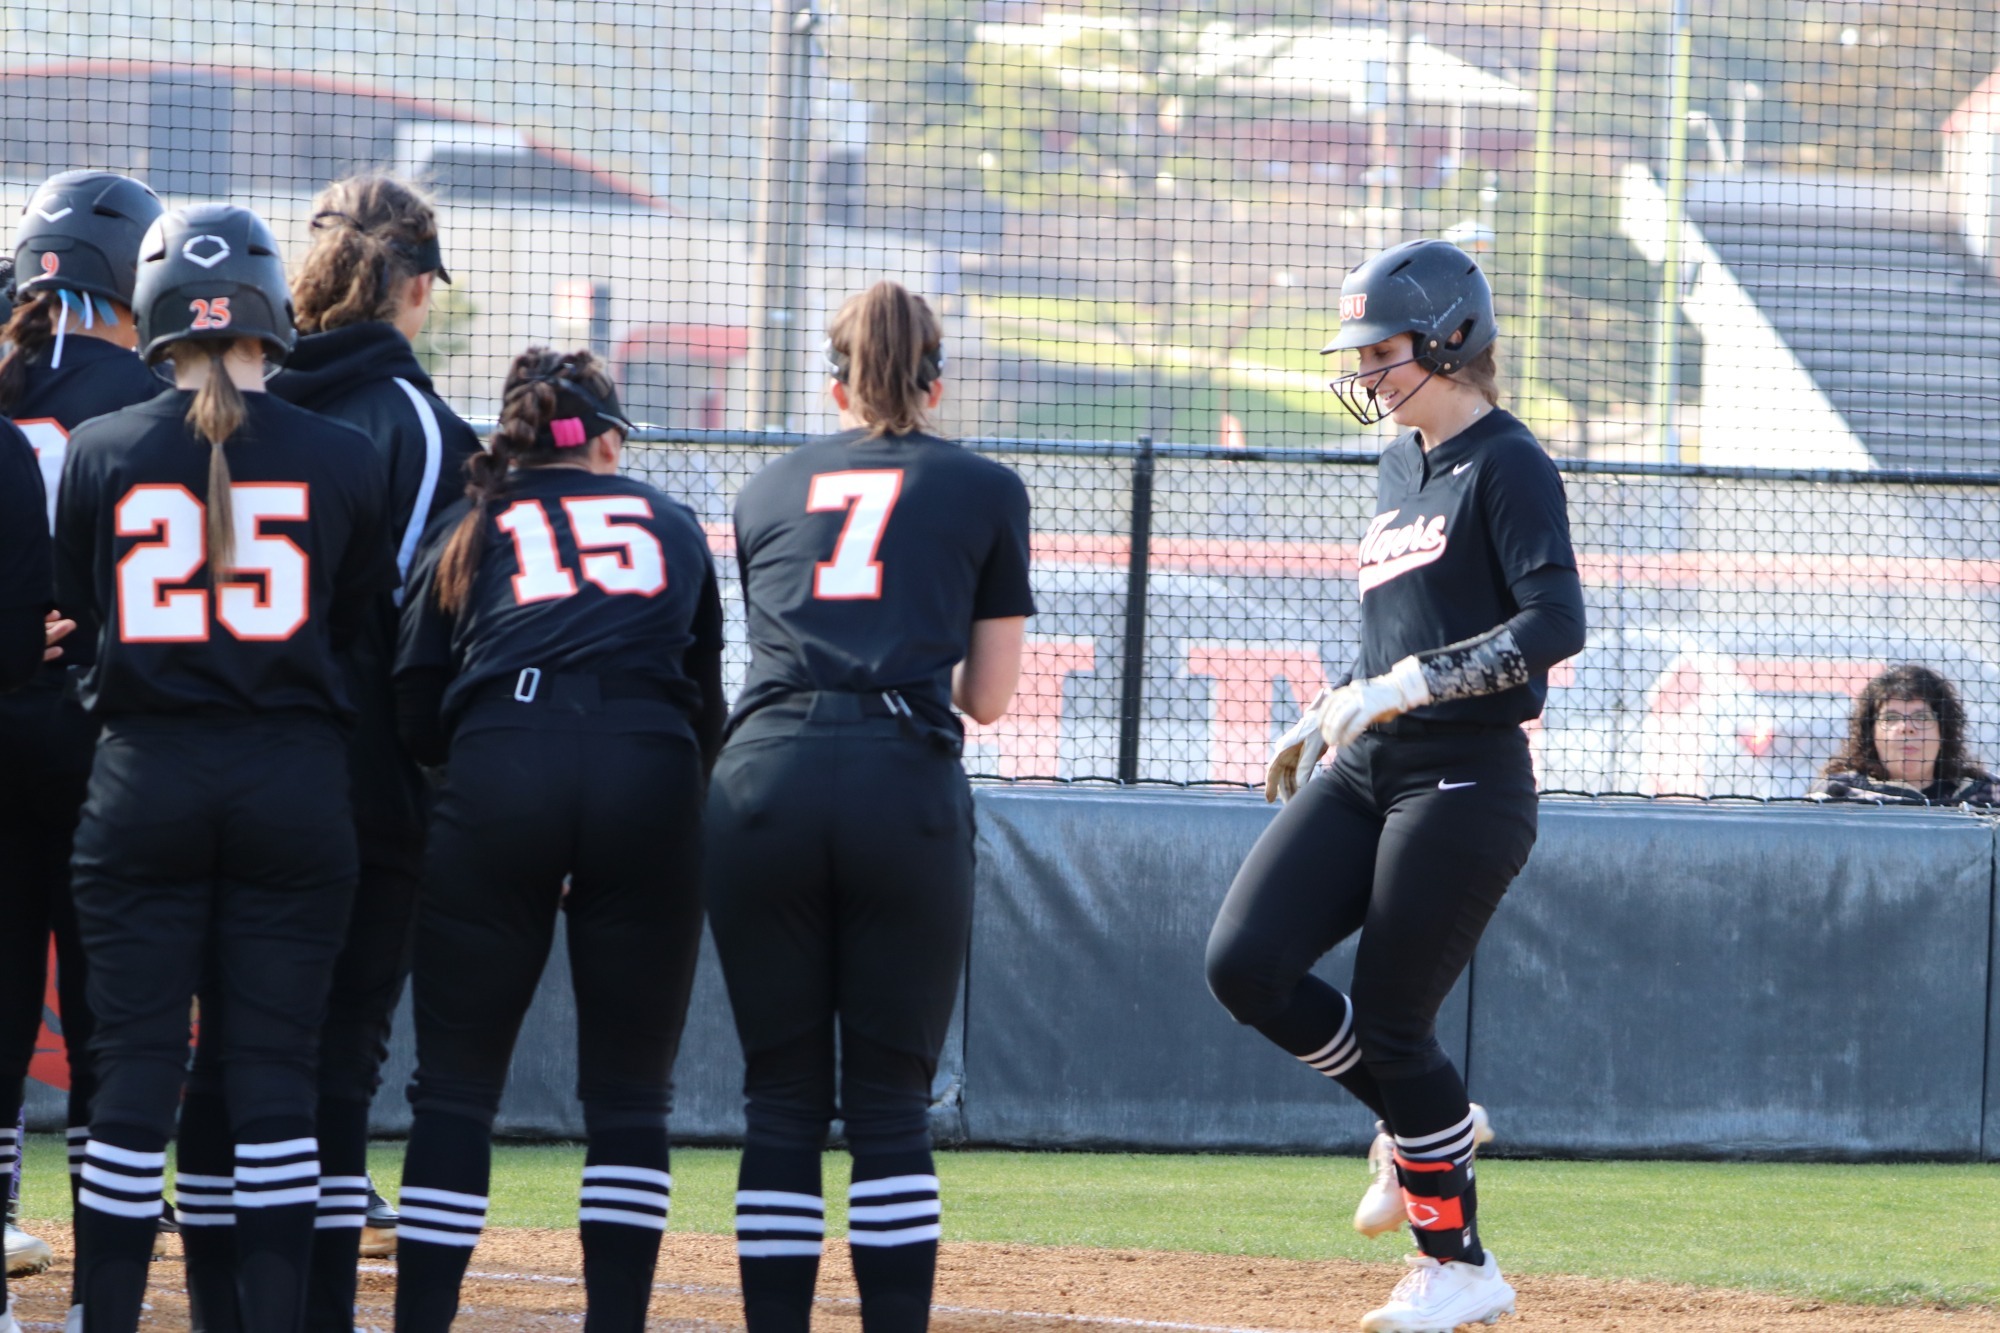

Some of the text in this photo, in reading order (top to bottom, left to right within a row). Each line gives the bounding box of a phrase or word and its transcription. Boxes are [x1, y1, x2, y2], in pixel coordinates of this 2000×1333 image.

[41, 252, 60, 278] 9
[189, 297, 232, 330] 25
[115, 482, 309, 643] 25
[497, 496, 667, 605] 15
[806, 469, 903, 599] 7
